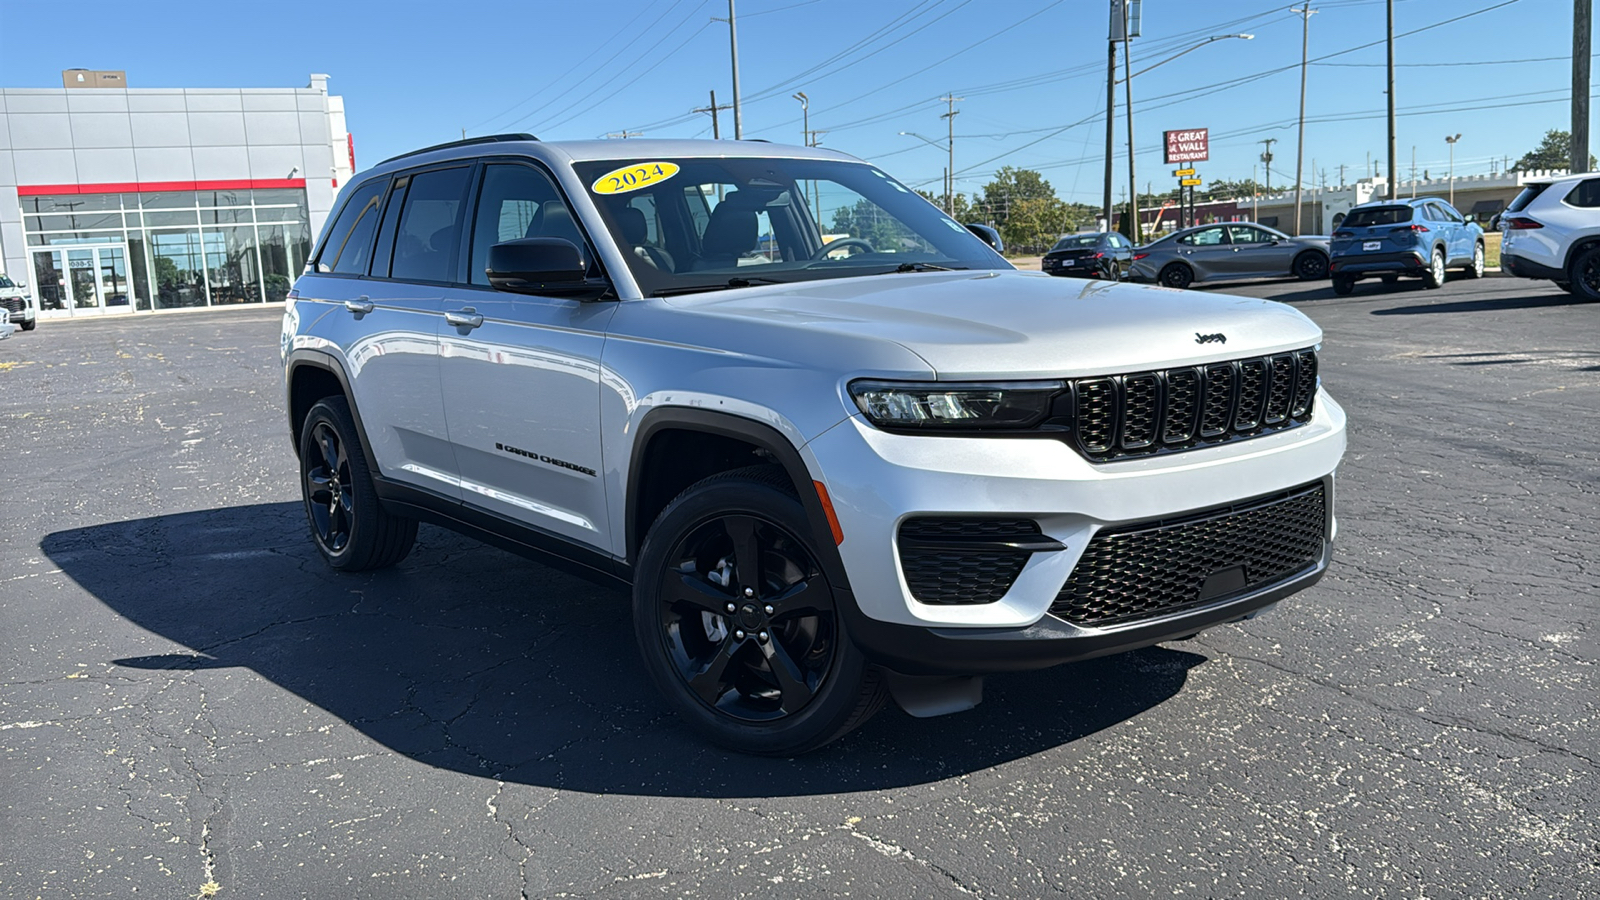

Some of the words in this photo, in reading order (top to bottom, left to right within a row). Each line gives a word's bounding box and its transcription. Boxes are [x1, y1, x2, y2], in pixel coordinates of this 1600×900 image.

[1177, 130, 1206, 142] GREAT
[1178, 142, 1206, 152] WALL
[1168, 151, 1207, 161] RESTAURANT
[608, 164, 664, 191] 2024
[1194, 332, 1227, 344] Jeep
[504, 445, 539, 460] GRAND
[540, 455, 597, 477] CHEROKEE
